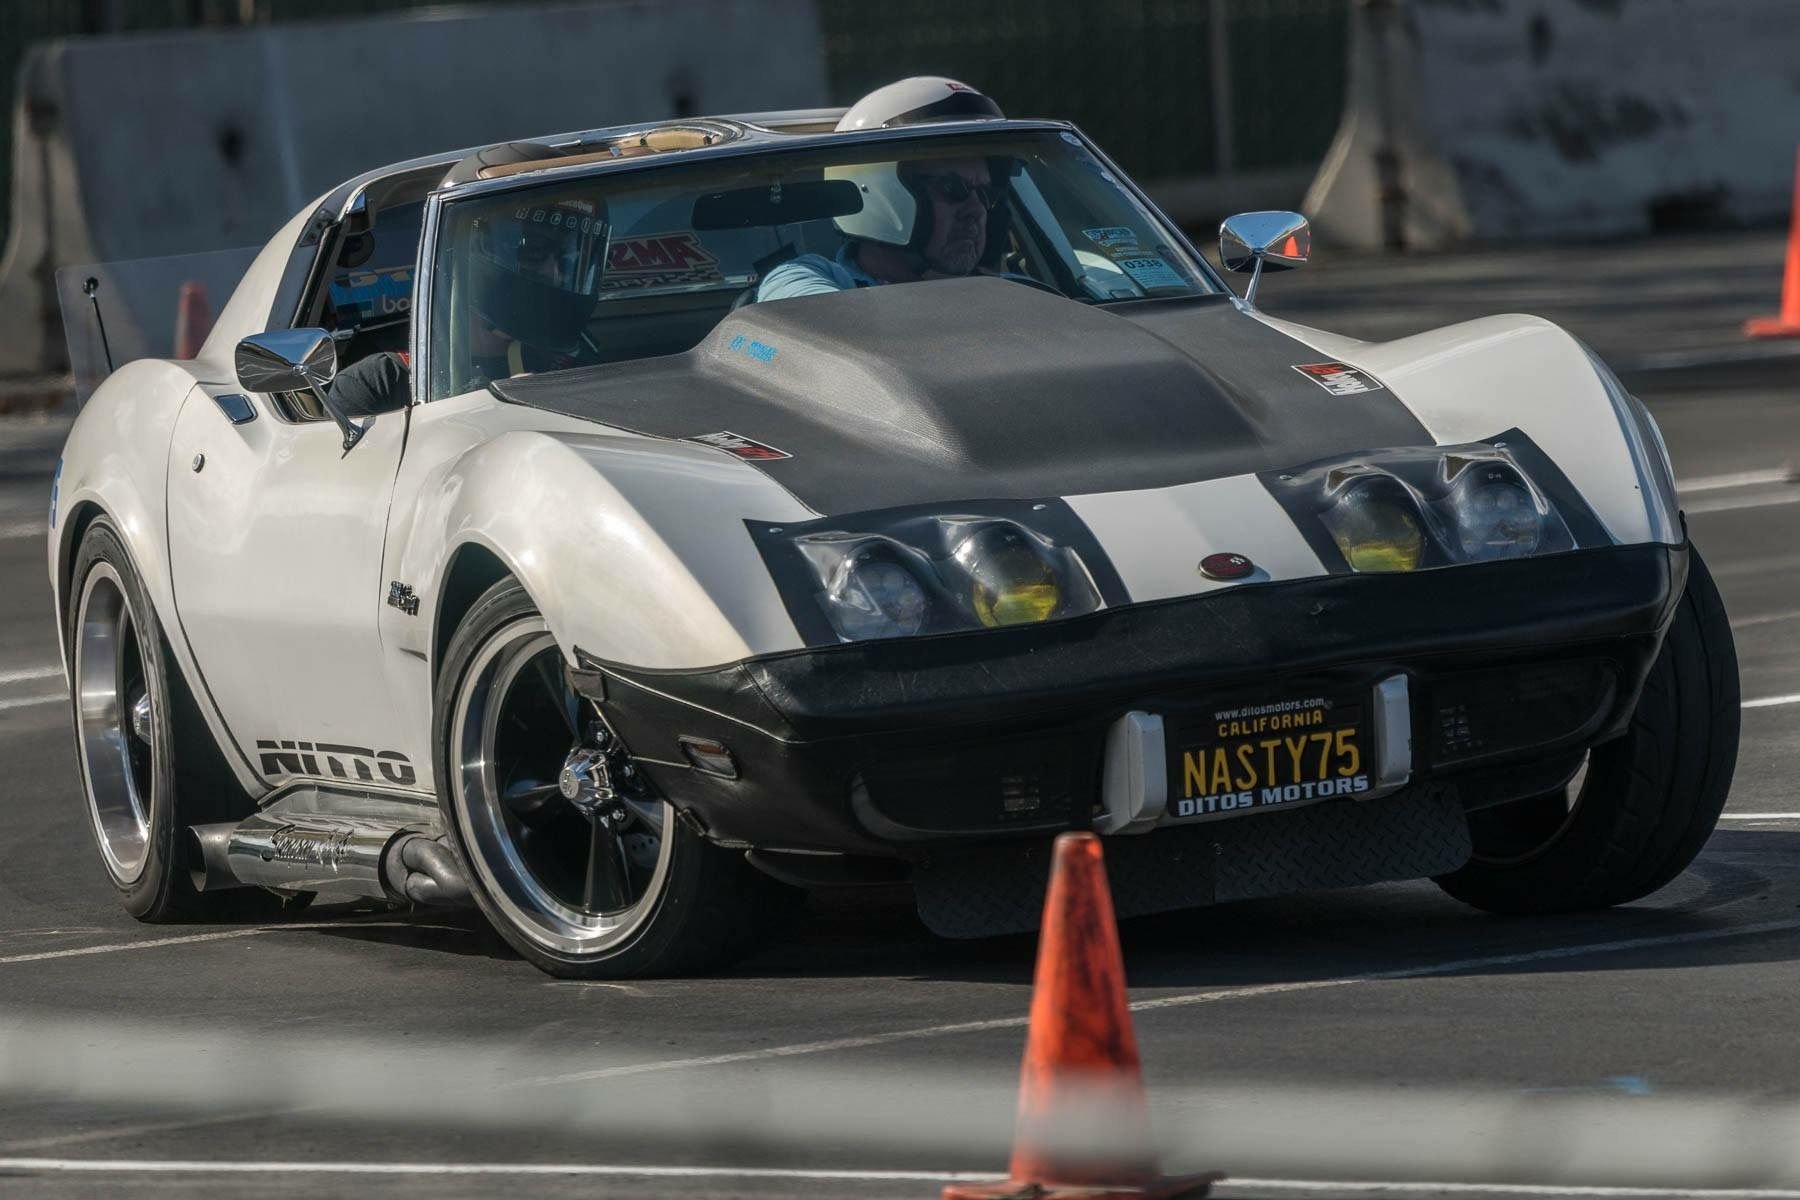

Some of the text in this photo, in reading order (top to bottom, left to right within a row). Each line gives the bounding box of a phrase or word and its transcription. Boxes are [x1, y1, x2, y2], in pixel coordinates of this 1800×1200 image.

[1215, 698, 1325, 721] www.ditosmotors.com
[1218, 710, 1323, 738] CALIFORNIA
[256, 740, 417, 786] NITTO
[1183, 729, 1360, 798] NASTY75
[1178, 775, 1369, 817] DITOS MOTORS
